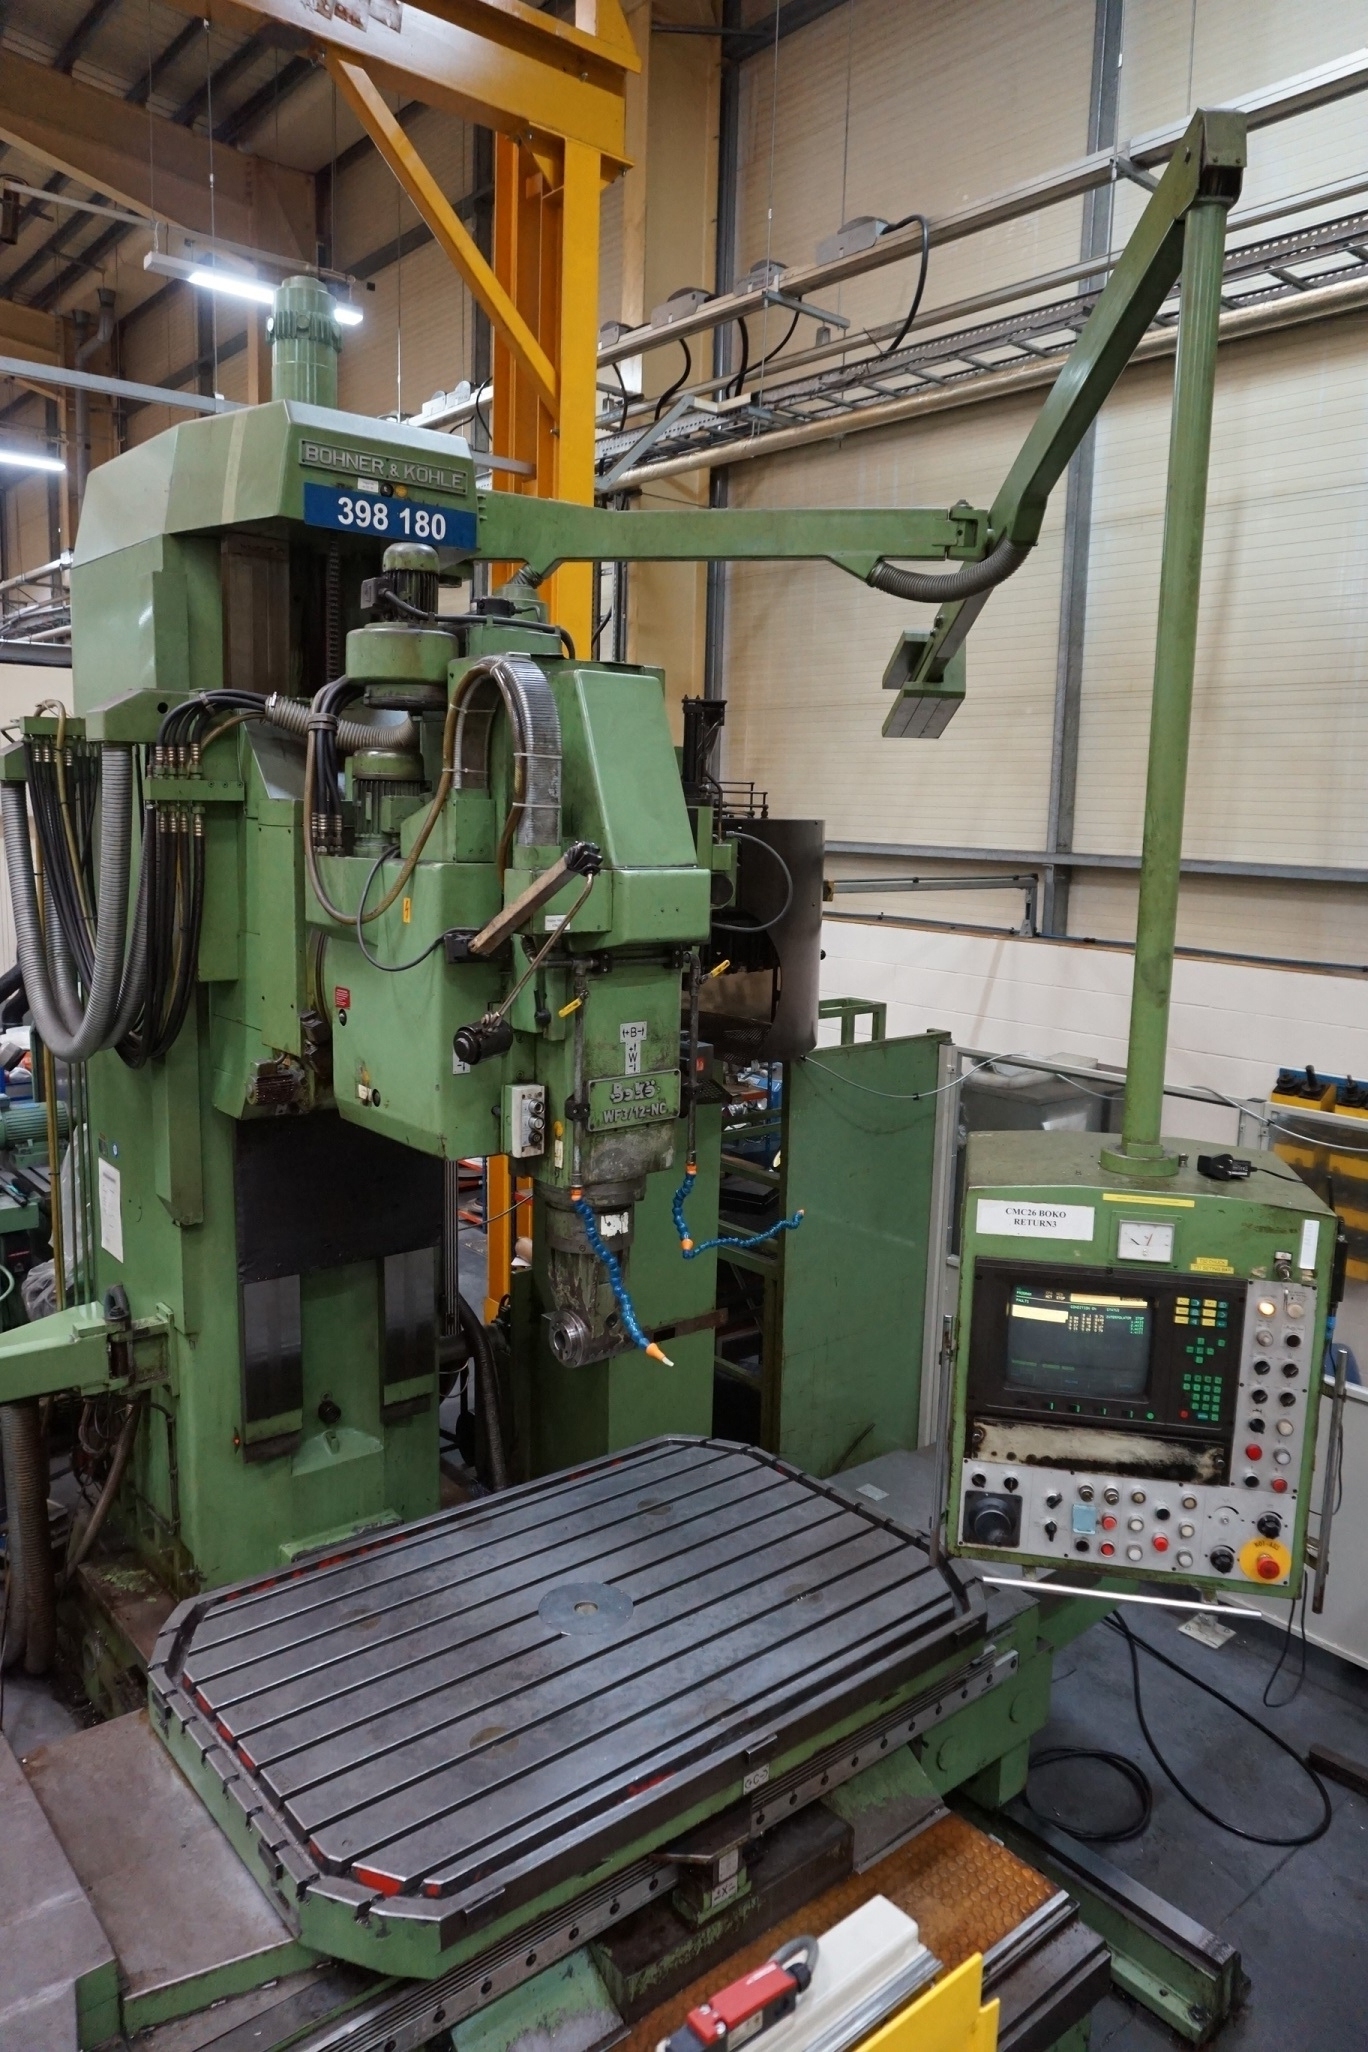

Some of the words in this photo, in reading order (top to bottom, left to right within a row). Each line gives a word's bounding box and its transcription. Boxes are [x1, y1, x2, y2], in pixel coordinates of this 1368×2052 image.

[390, 463, 400, 478] &
[337, 497, 389, 531] 398
[400, 508, 446, 540] 180
[603, 1102, 668, 1124] WF3/12-NC
[1005, 1207, 1037, 1218] CMC26
[1039, 1210, 1067, 1219] BOKO
[1013, 1217, 1058, 1228] RETURN3
